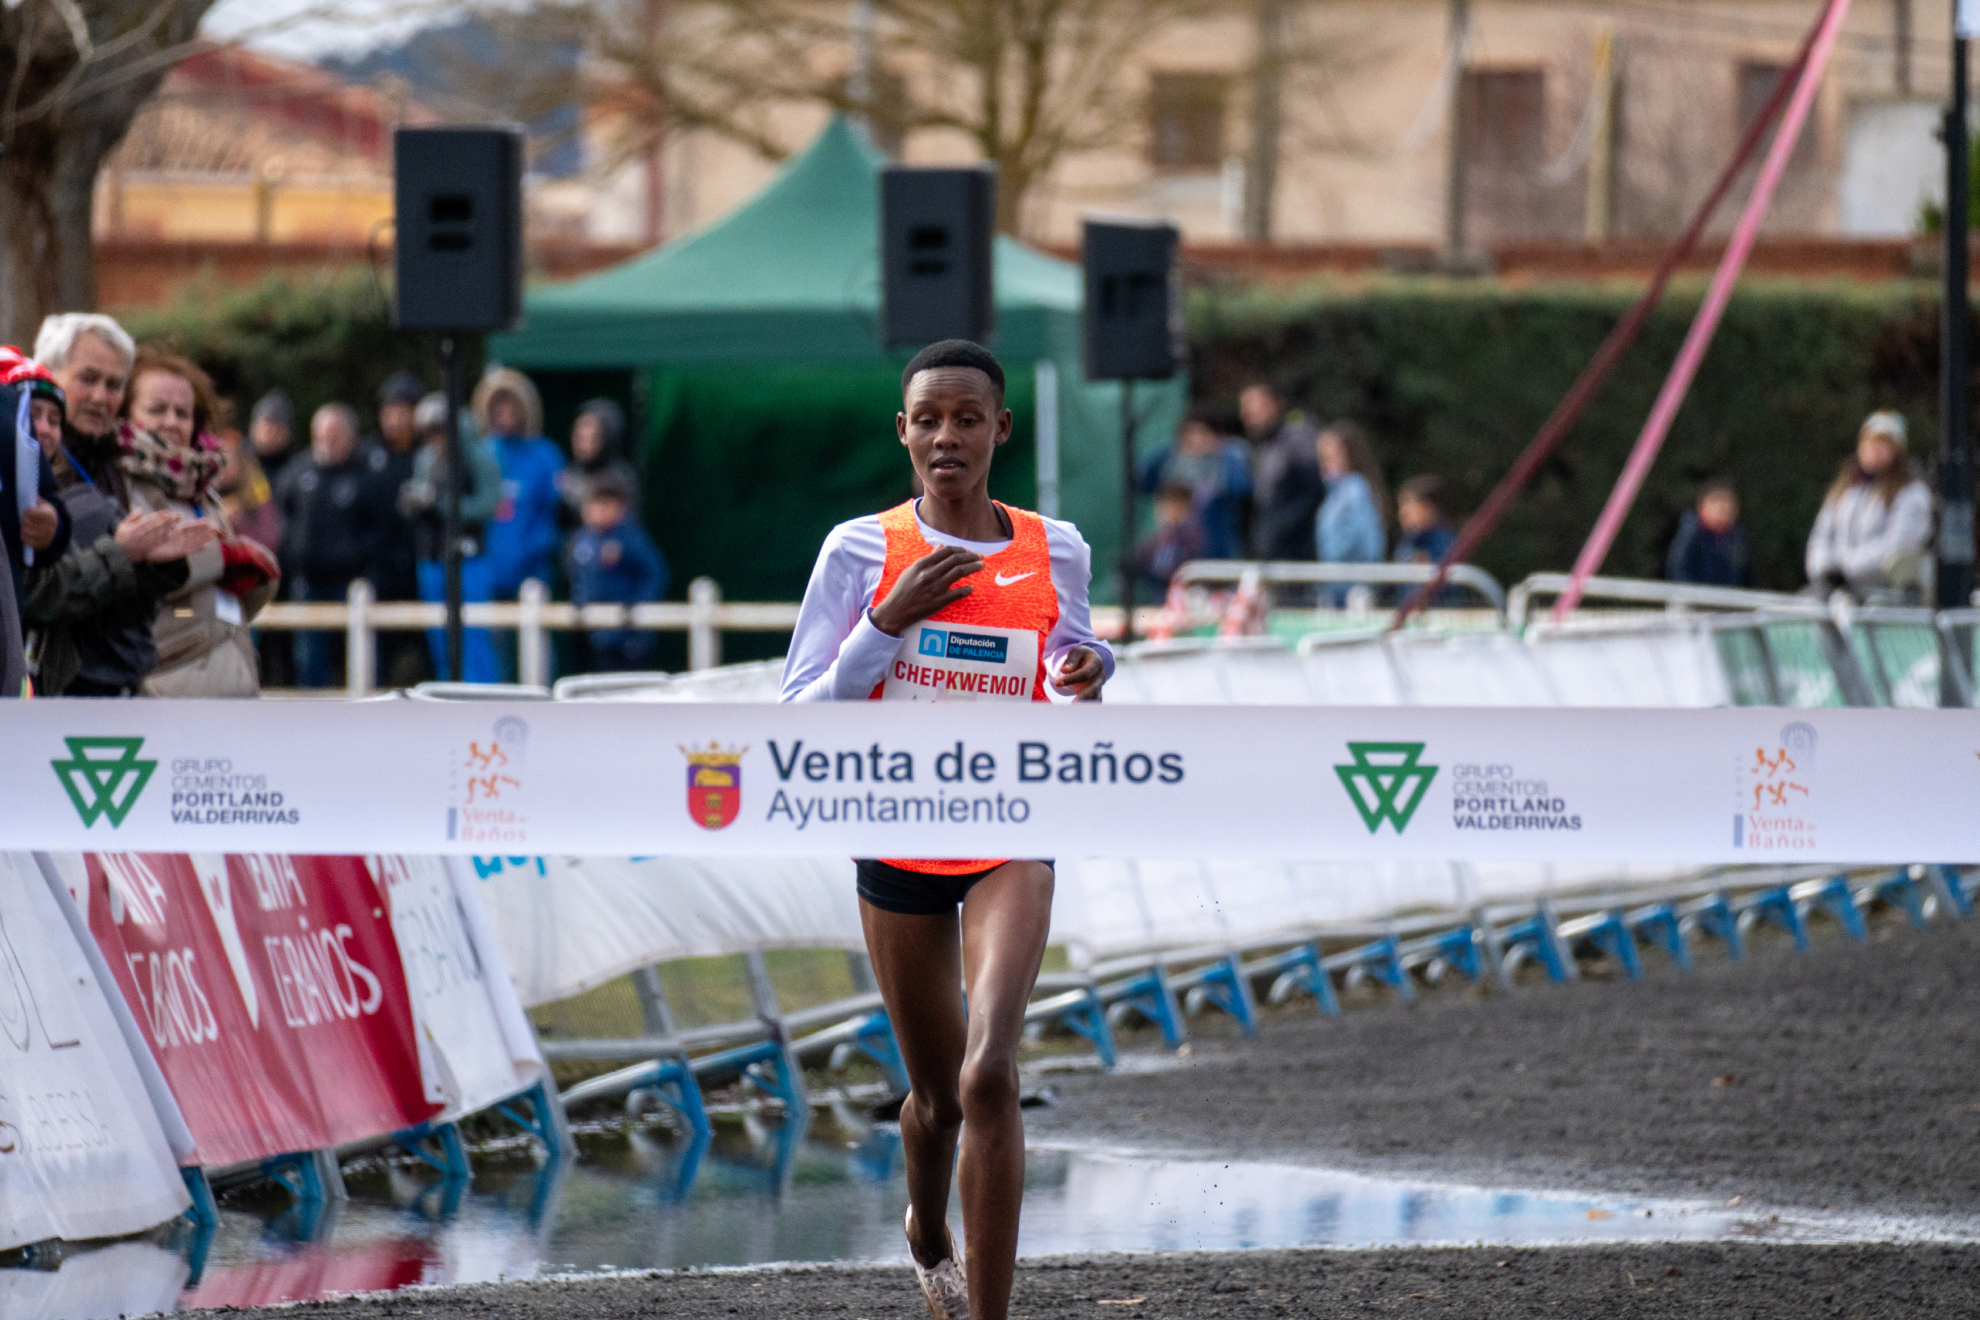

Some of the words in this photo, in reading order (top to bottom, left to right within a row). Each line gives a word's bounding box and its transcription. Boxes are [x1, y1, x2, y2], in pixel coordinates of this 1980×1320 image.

[950, 635, 996, 649] Diputación
[949, 646, 961, 656] DE
[963, 647, 1005, 660] PALENCIA
[895, 660, 1027, 697] CHEPKWEMOI
[171, 759, 233, 775] GRUPO
[766, 739, 914, 782] Venta
[934, 741, 996, 783] de
[1018, 740, 1185, 784] Baños
[1453, 764, 1513, 780] GRUPO
[171, 774, 267, 791] CEMENTOS
[1453, 780, 1548, 796] CEMENTOS
[172, 792, 284, 807] PORTLAND
[1454, 797, 1565, 813] PORTLAND
[171, 809, 300, 825] VALDERRIVAS
[766, 788, 1031, 830] Ayuntamiento
[1453, 815, 1582, 831] VALDERRIVAS
